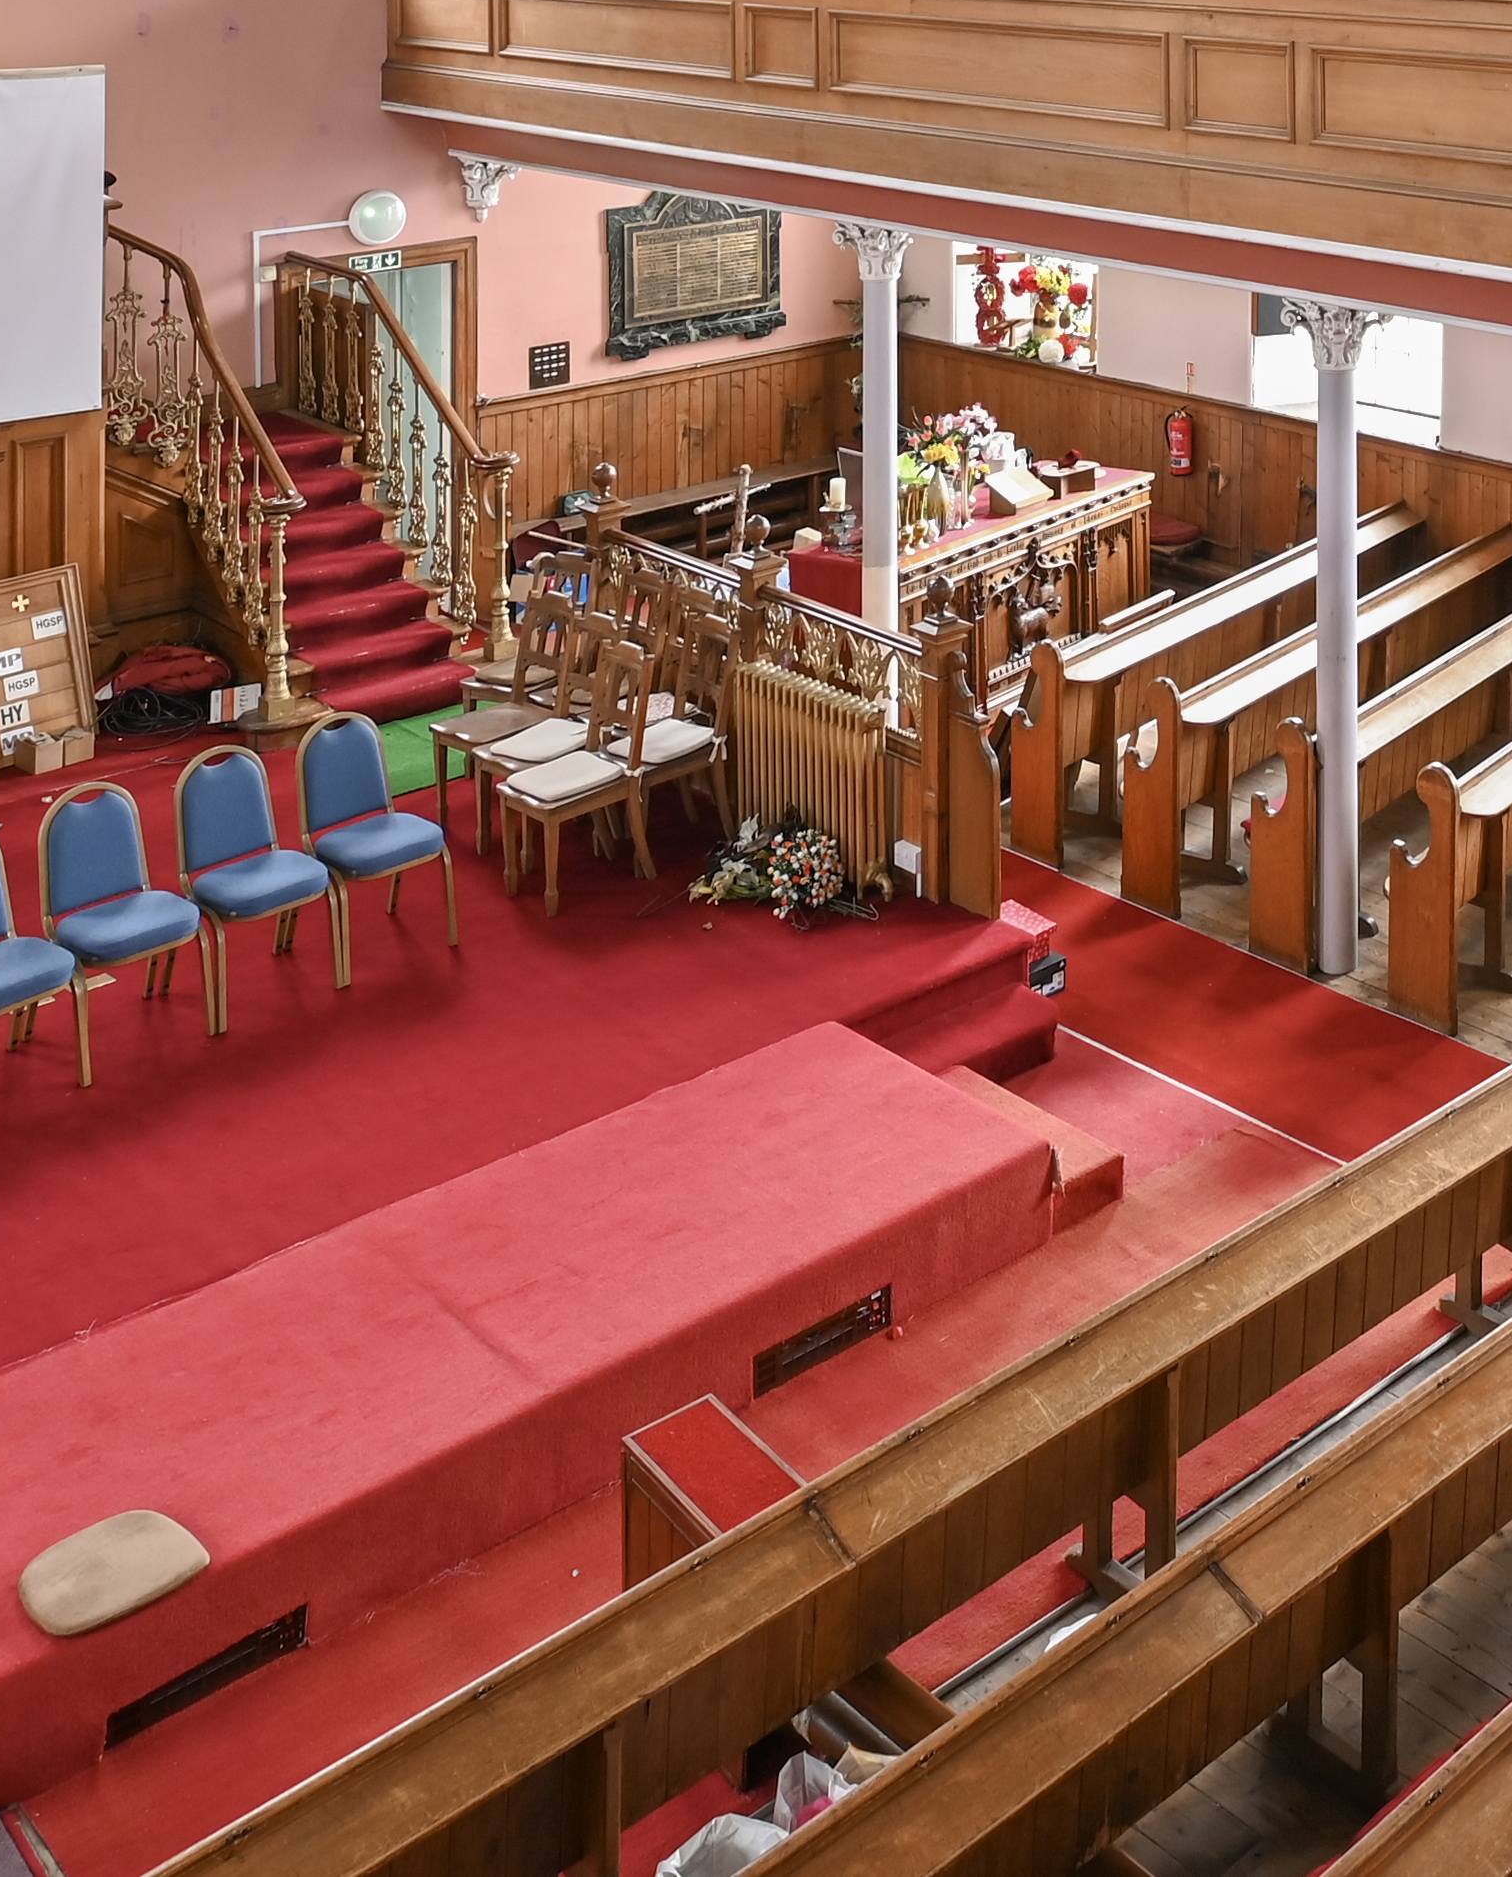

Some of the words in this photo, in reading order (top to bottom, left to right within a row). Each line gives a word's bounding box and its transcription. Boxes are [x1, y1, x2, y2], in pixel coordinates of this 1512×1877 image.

[36, 615, 63, 629] HGSP
[8, 677, 36, 692] HGSP
[1, 703, 23, 725] HY
